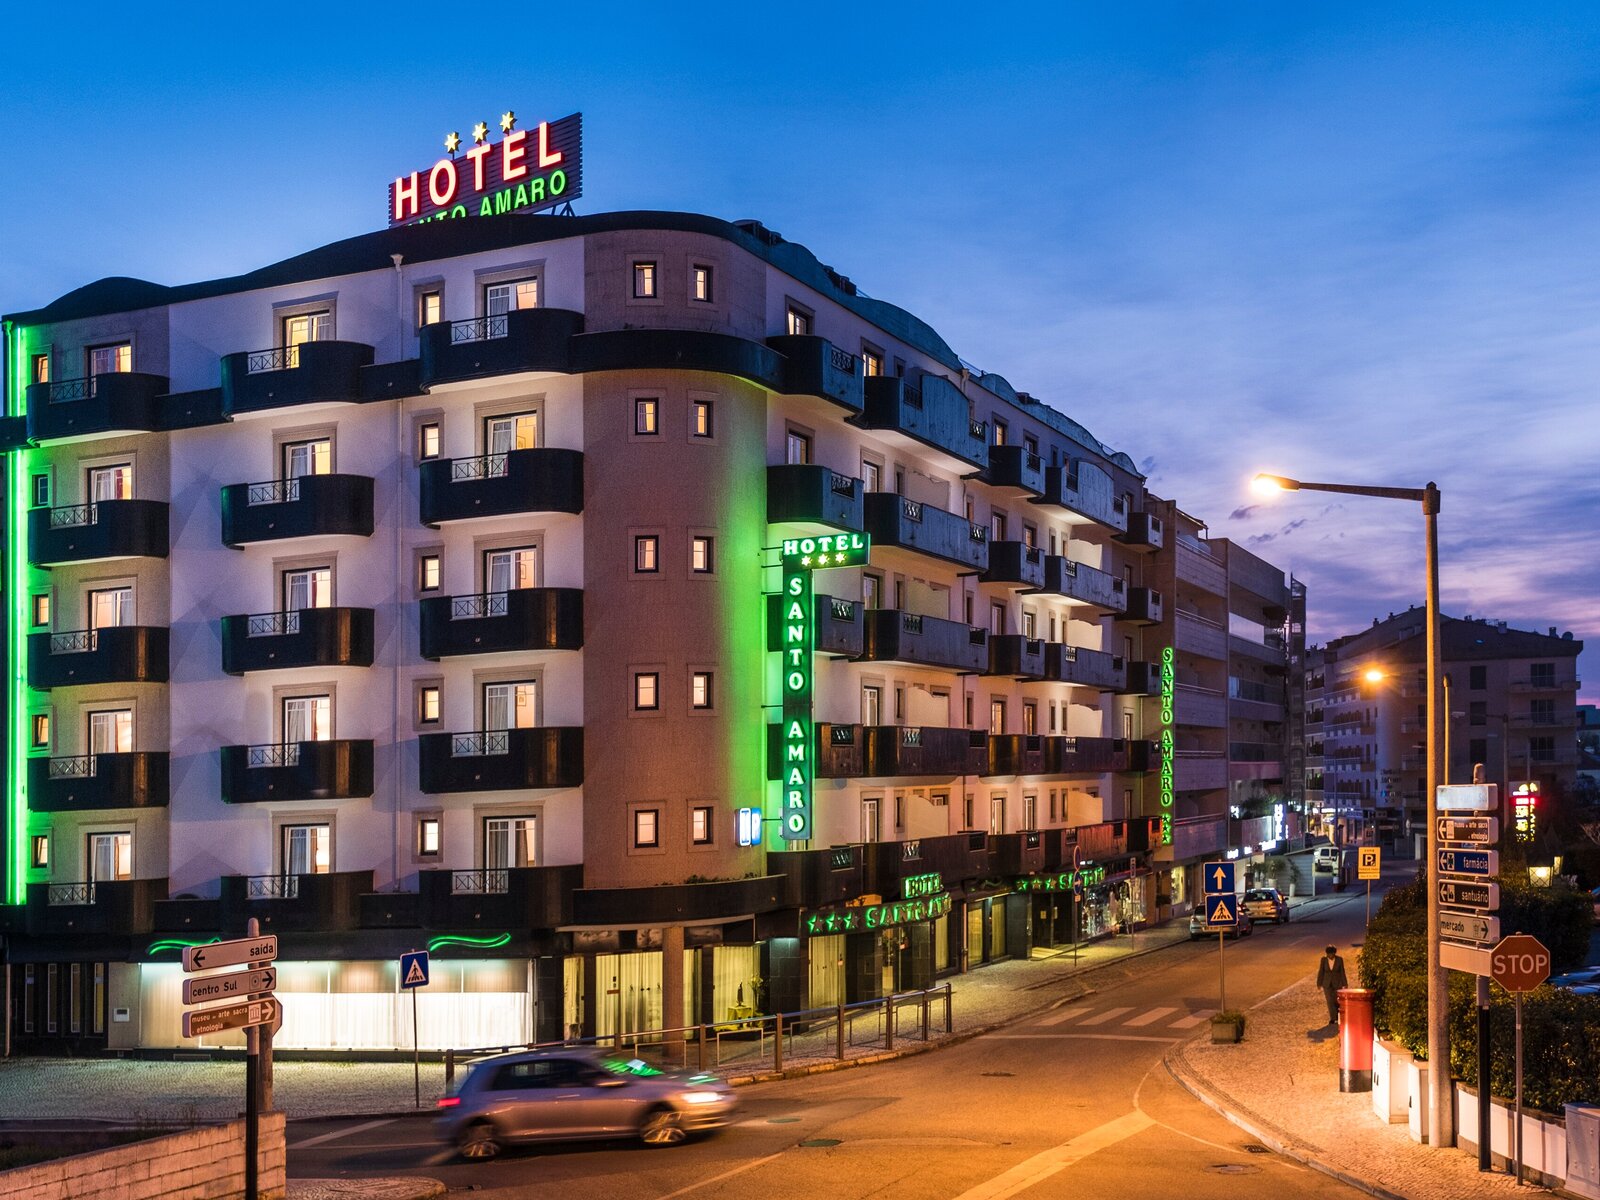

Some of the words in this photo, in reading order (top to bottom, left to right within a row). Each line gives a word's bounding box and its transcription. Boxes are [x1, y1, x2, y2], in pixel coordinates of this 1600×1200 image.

[395, 121, 564, 221] HOTEL
[479, 169, 567, 218] AMARO
[784, 533, 864, 556] HOTEL
[788, 577, 805, 691] SANTO
[1160, 647, 1174, 726] SANTO
[788, 720, 805, 833] AMARO
[1160, 729, 1174, 808] AMARO
[1463, 856, 1488, 870] farmácia
[1461, 890, 1489, 903] santuário
[1441, 920, 1465, 933] mercado
[250, 943, 274, 957] saída
[1493, 954, 1548, 975] STOP
[192, 983, 220, 997] centro
[223, 980, 238, 992] Sul
[192, 1015, 211, 1023] museu
[218, 1010, 231, 1018] arte
[233, 1007, 248, 1016] sacra
[197, 1022, 224, 1034] etnologia
